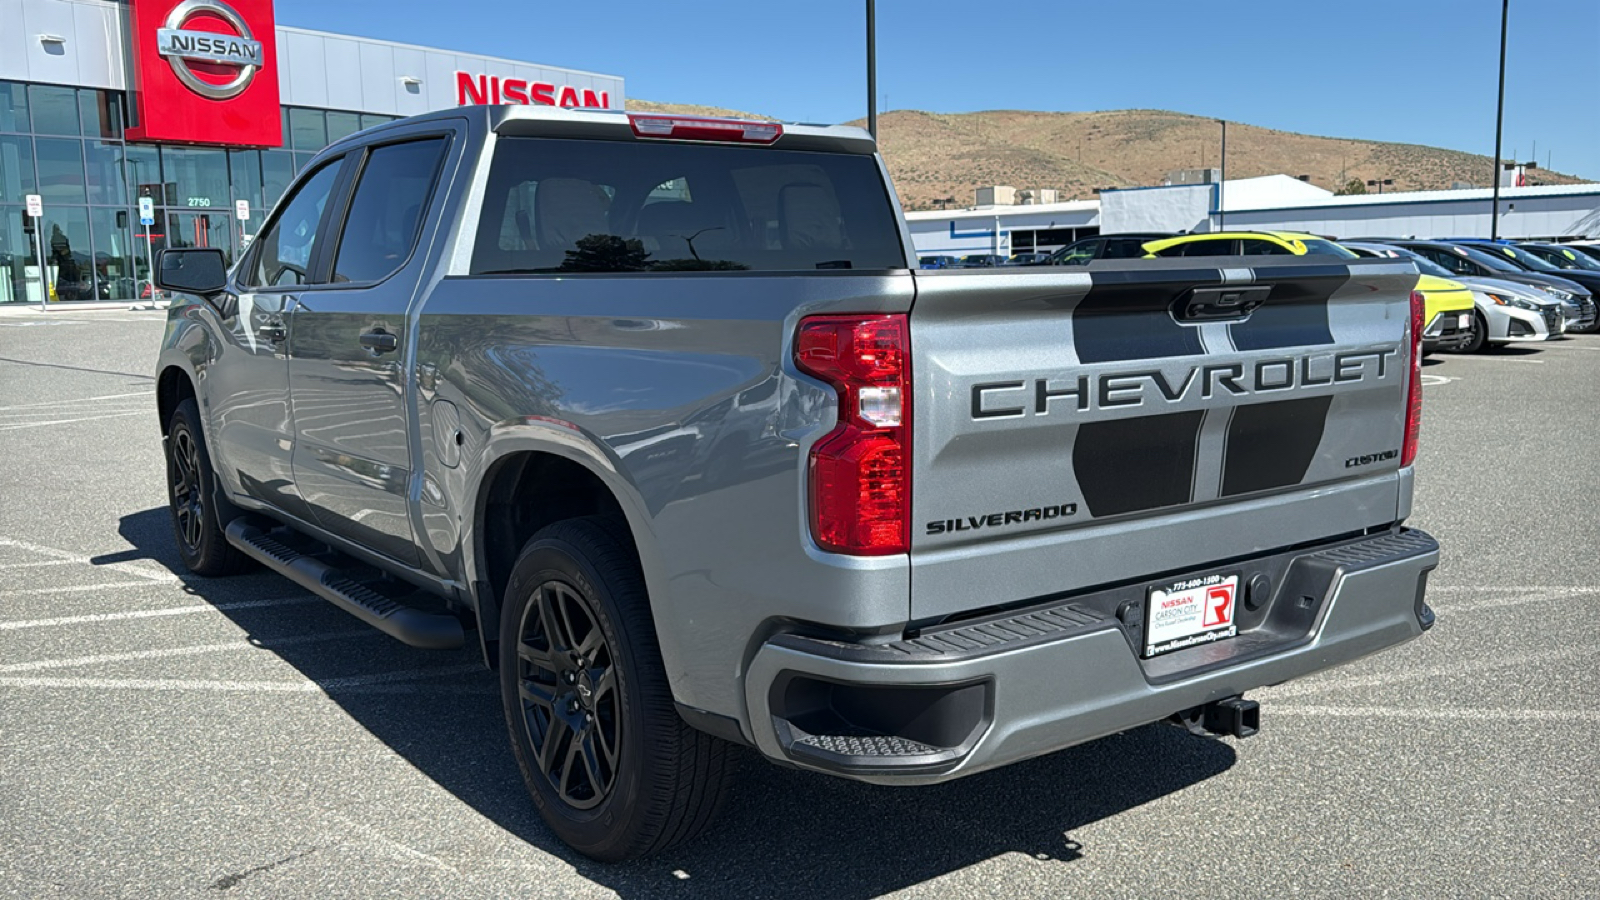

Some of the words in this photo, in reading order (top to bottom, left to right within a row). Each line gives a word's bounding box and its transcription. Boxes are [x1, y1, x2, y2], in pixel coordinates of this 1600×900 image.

[171, 34, 257, 58] NISSAN
[455, 71, 610, 109] NISSAN
[188, 197, 211, 207] 2750
[970, 348, 1397, 420] CHEVROLET
[1345, 449, 1399, 468] CUSTOM
[925, 502, 1078, 535] SILVERADO
[1173, 575, 1219, 590] 775-600-1500
[1155, 607, 1182, 620] CARSON
[1184, 604, 1198, 615] CITY
[1161, 596, 1194, 609] NISSAN
